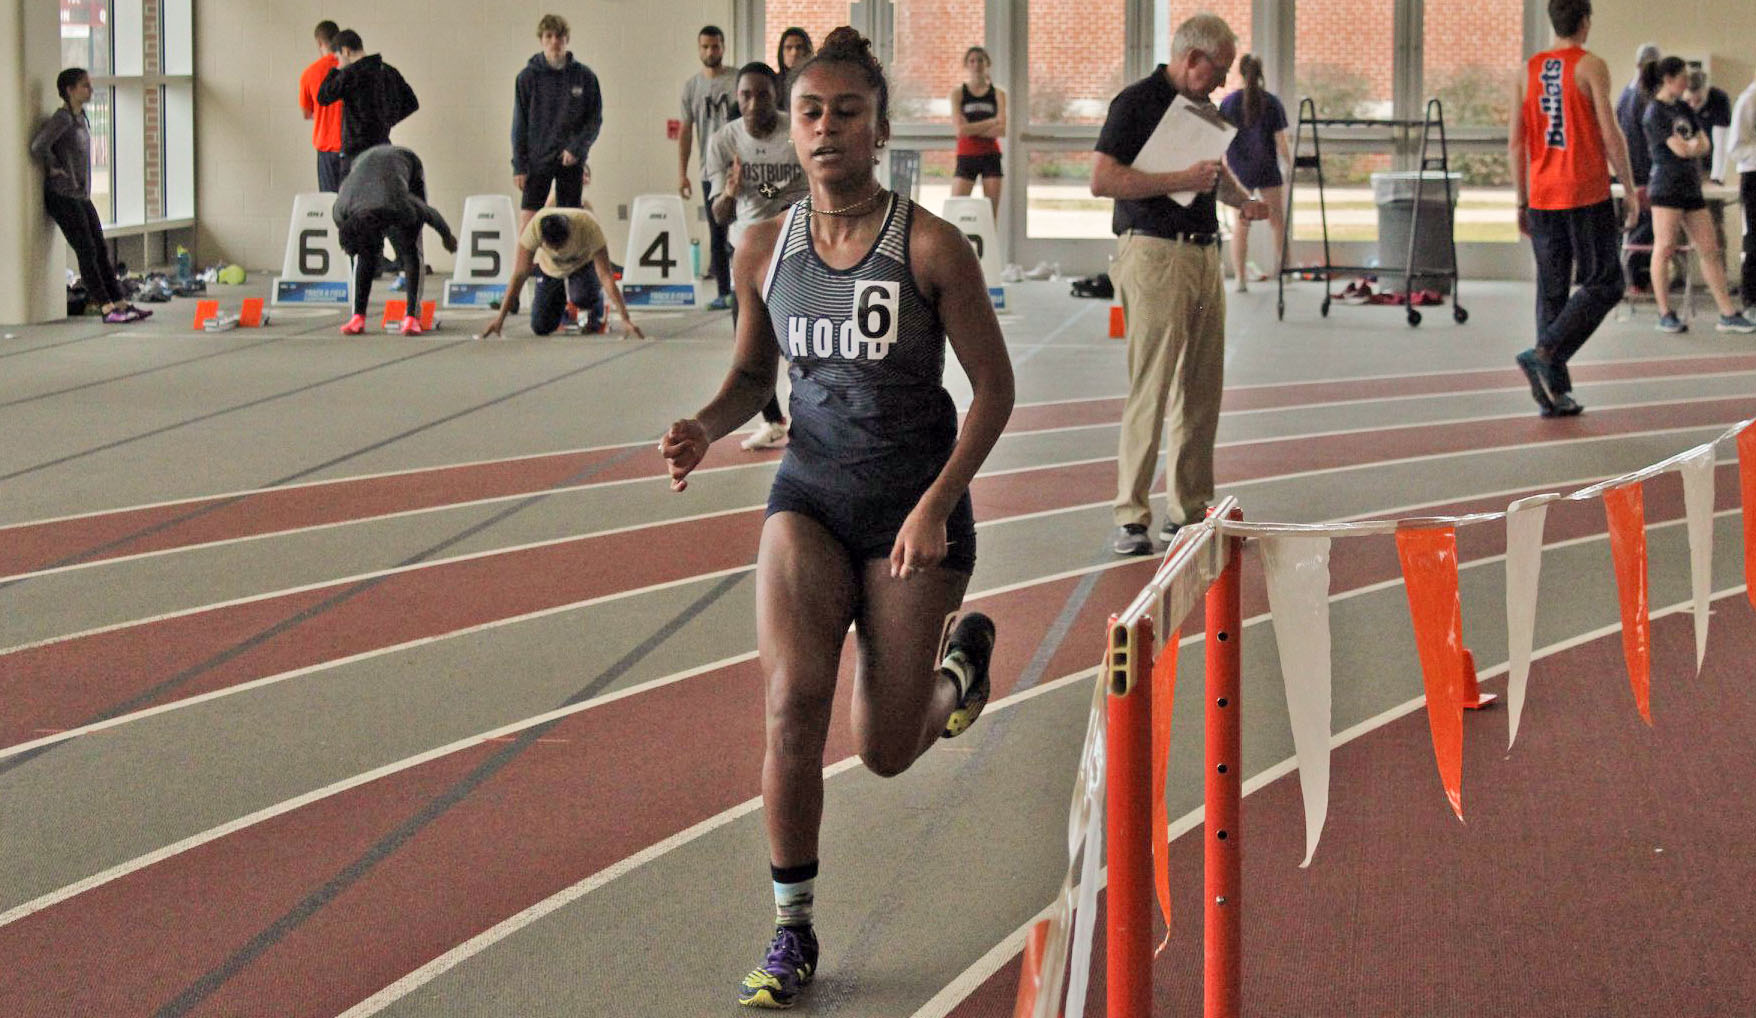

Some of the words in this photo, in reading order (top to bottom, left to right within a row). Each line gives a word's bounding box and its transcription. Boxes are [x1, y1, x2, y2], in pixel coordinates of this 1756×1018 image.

[299, 229, 329, 275] 6
[471, 231, 501, 277] 5
[639, 231, 677, 278] 4
[857, 285, 891, 338] 6
